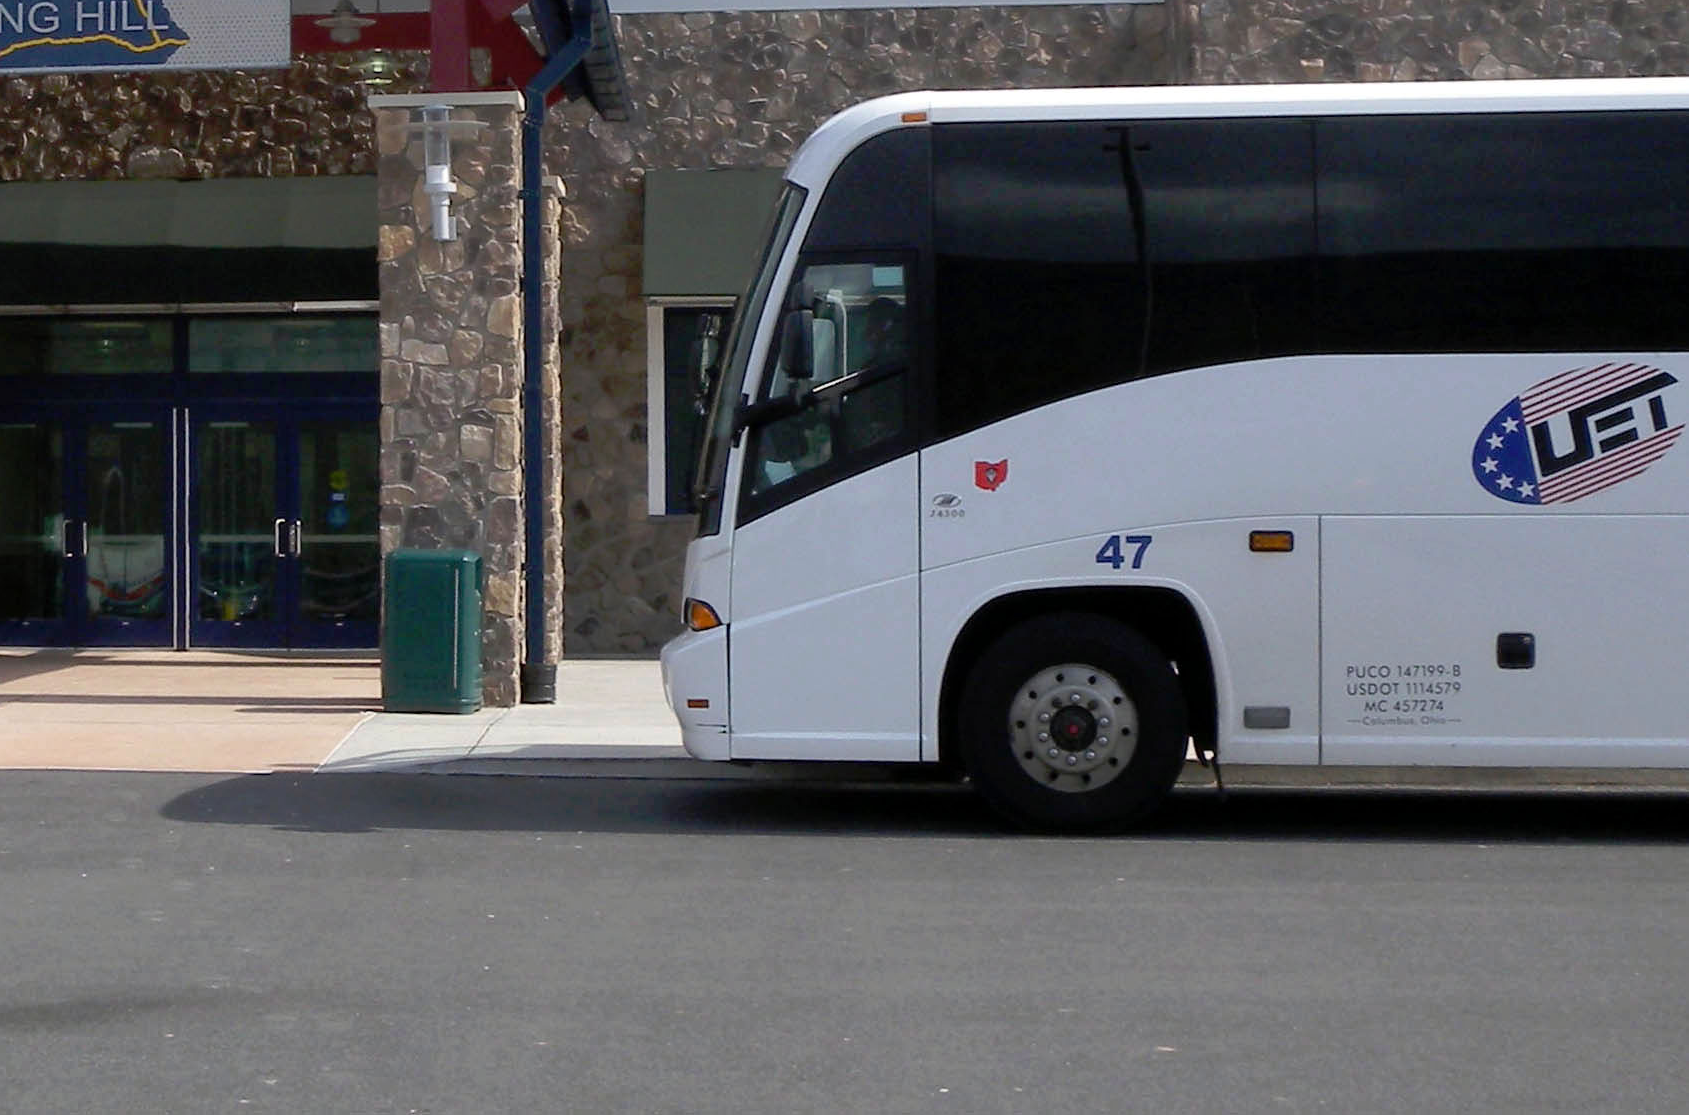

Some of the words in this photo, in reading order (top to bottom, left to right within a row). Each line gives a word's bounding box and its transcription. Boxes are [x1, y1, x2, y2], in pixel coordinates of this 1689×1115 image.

[75, 0, 169, 32] HILL
[1095, 534, 1153, 570] 47
[1346, 665, 1391, 679] PUCO
[1397, 664, 1461, 678] 147199-B
[1347, 682, 1400, 696] USDOT
[1406, 681, 1461, 696] 1114579
[1363, 699, 1389, 713] MC
[1393, 699, 1444, 713] 457274
